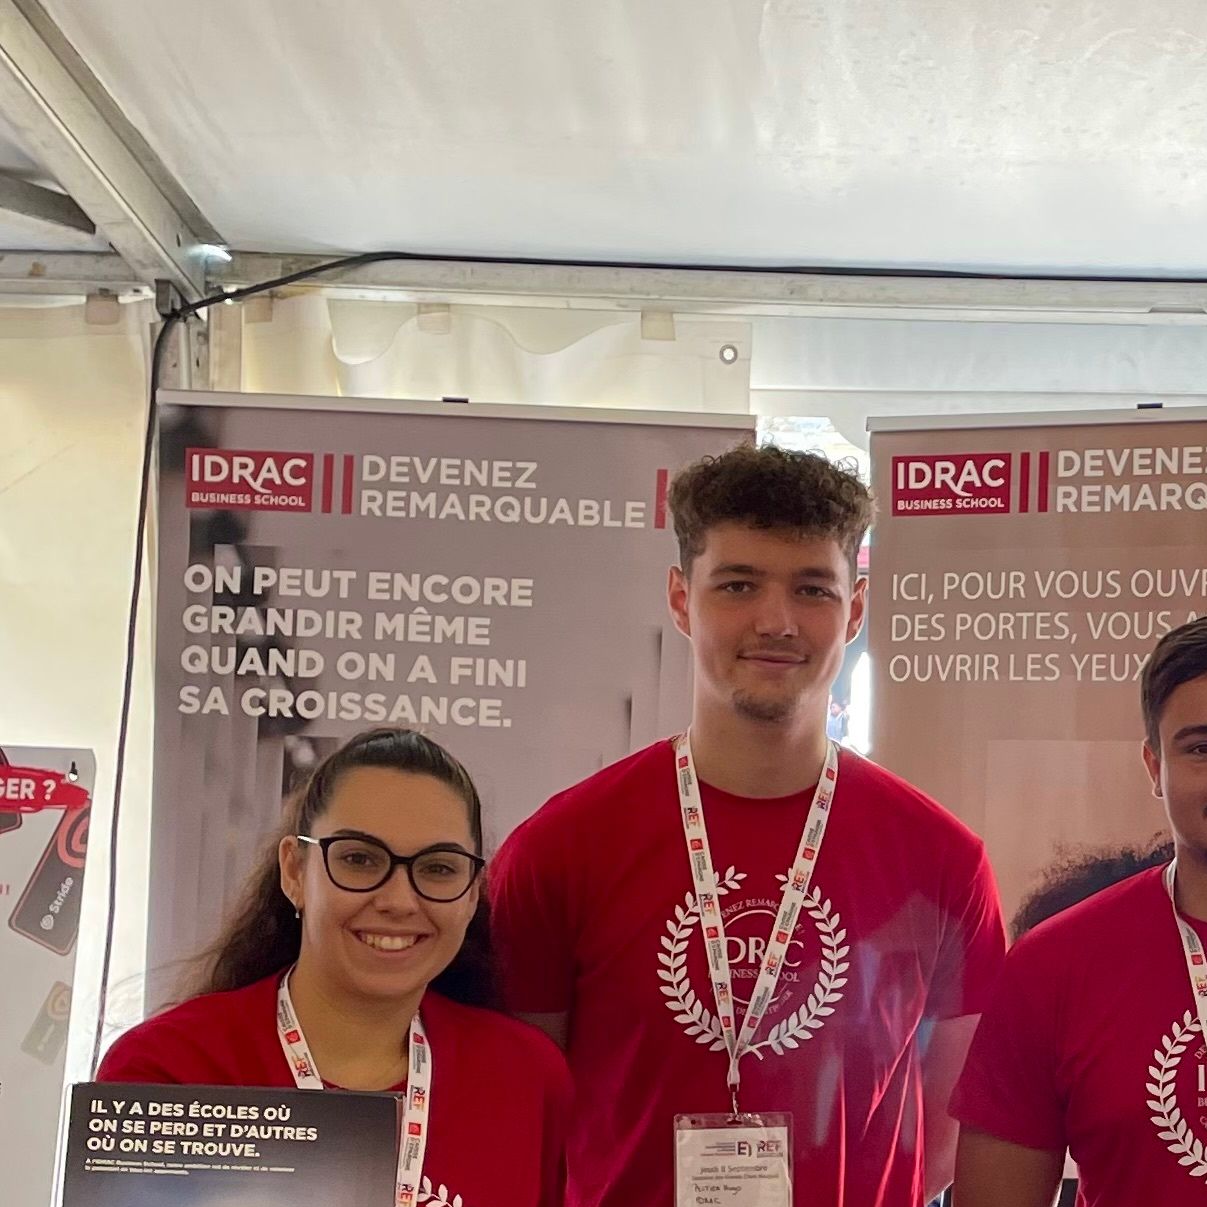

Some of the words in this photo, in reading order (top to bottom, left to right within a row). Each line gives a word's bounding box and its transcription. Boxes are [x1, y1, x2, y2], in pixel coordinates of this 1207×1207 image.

[191, 454, 307, 493] IDRAC
[361, 455, 537, 489] DEVENEZ
[897, 459, 1006, 497] IDRAC
[191, 491, 251, 505] BUSINESS
[254, 494, 306, 507] SCHOOL
[360, 489, 646, 529] REMARQUABLE
[897, 497, 952, 511] BUSINESS
[955, 496, 1004, 509] SCHOOL
[184, 564, 241, 594] ON
[253, 566, 356, 599] PEUT
[368, 571, 534, 608] ENCORE
[892, 572, 935, 603] ICI,
[943, 571, 1026, 599] POUR
[1034, 570, 1121, 598] VOUS
[182, 605, 363, 640] GRANDIR
[374, 606, 491, 646] MÊME
[891, 613, 946, 642] DES
[955, 612, 1078, 645] PORTES,
[1086, 610, 1171, 640] VOUS
[180, 645, 325, 679] QUAND
[336, 656, 396, 682] ON
[407, 656, 438, 684] A
[450, 657, 527, 688] FINI
[889, 653, 999, 683] OUVRIR
[1009, 653, 1060, 682] LES
[1069, 653, 1149, 682] YEUX
[178, 686, 229, 716] SA
[240, 687, 512, 728] CROISSANCE.
[90, 1100, 107, 1113] IL
[112, 1101, 126, 1114] Y
[129, 1101, 143, 1115] A
[148, 1102, 184, 1117] DES
[188, 1101, 259, 1120] ÉCOLES
[263, 1104, 291, 1121] OÙ
[87, 1134, 115, 1150] OÙ
[120, 1138, 148, 1152] ON
[152, 1140, 175, 1154] SE
[181, 1141, 260, 1157] TROUVE.
[89, 1119, 118, 1133] ON
[122, 1120, 145, 1134] SE
[149, 1121, 198, 1136] PERD
[202, 1124, 227, 1137] ET
[230, 1124, 318, 1141] D'AUTRES
